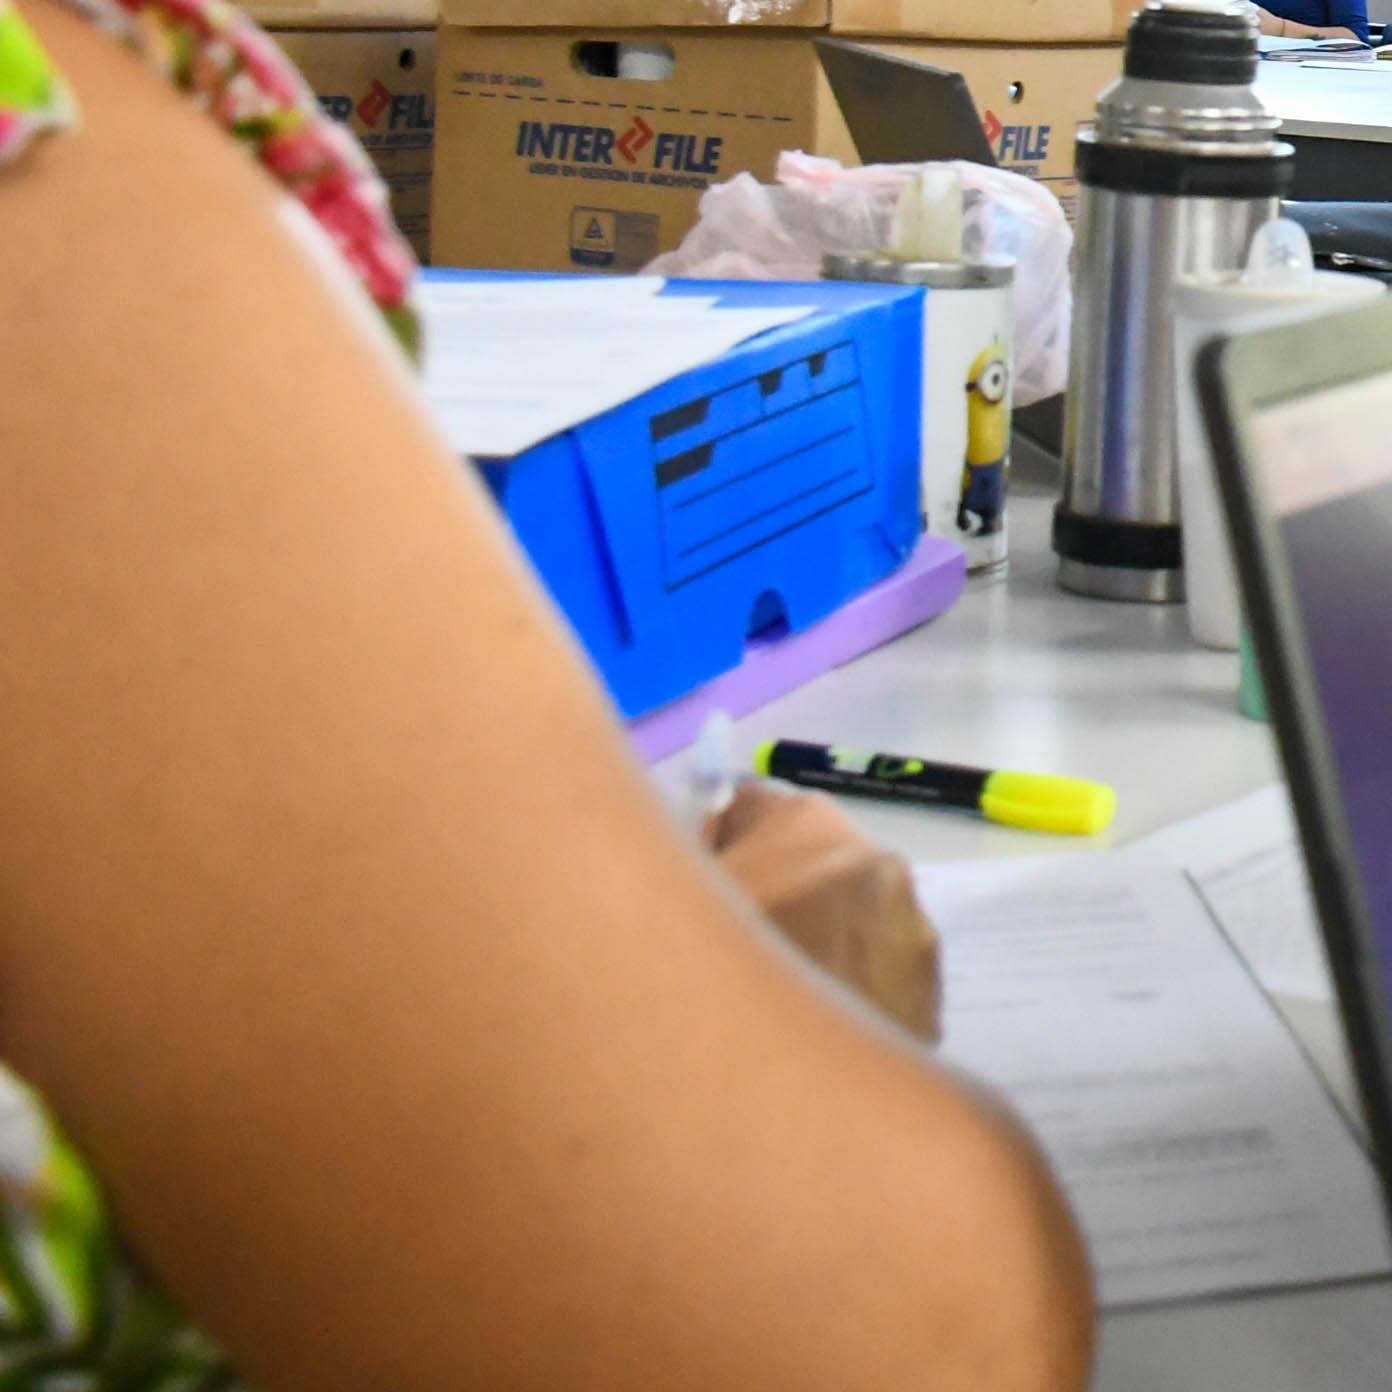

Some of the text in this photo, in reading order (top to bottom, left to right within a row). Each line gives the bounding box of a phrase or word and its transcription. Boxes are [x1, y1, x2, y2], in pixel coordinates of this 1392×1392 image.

[516, 121, 723, 174] INTER FILE
[998, 126, 1050, 161] FILE
